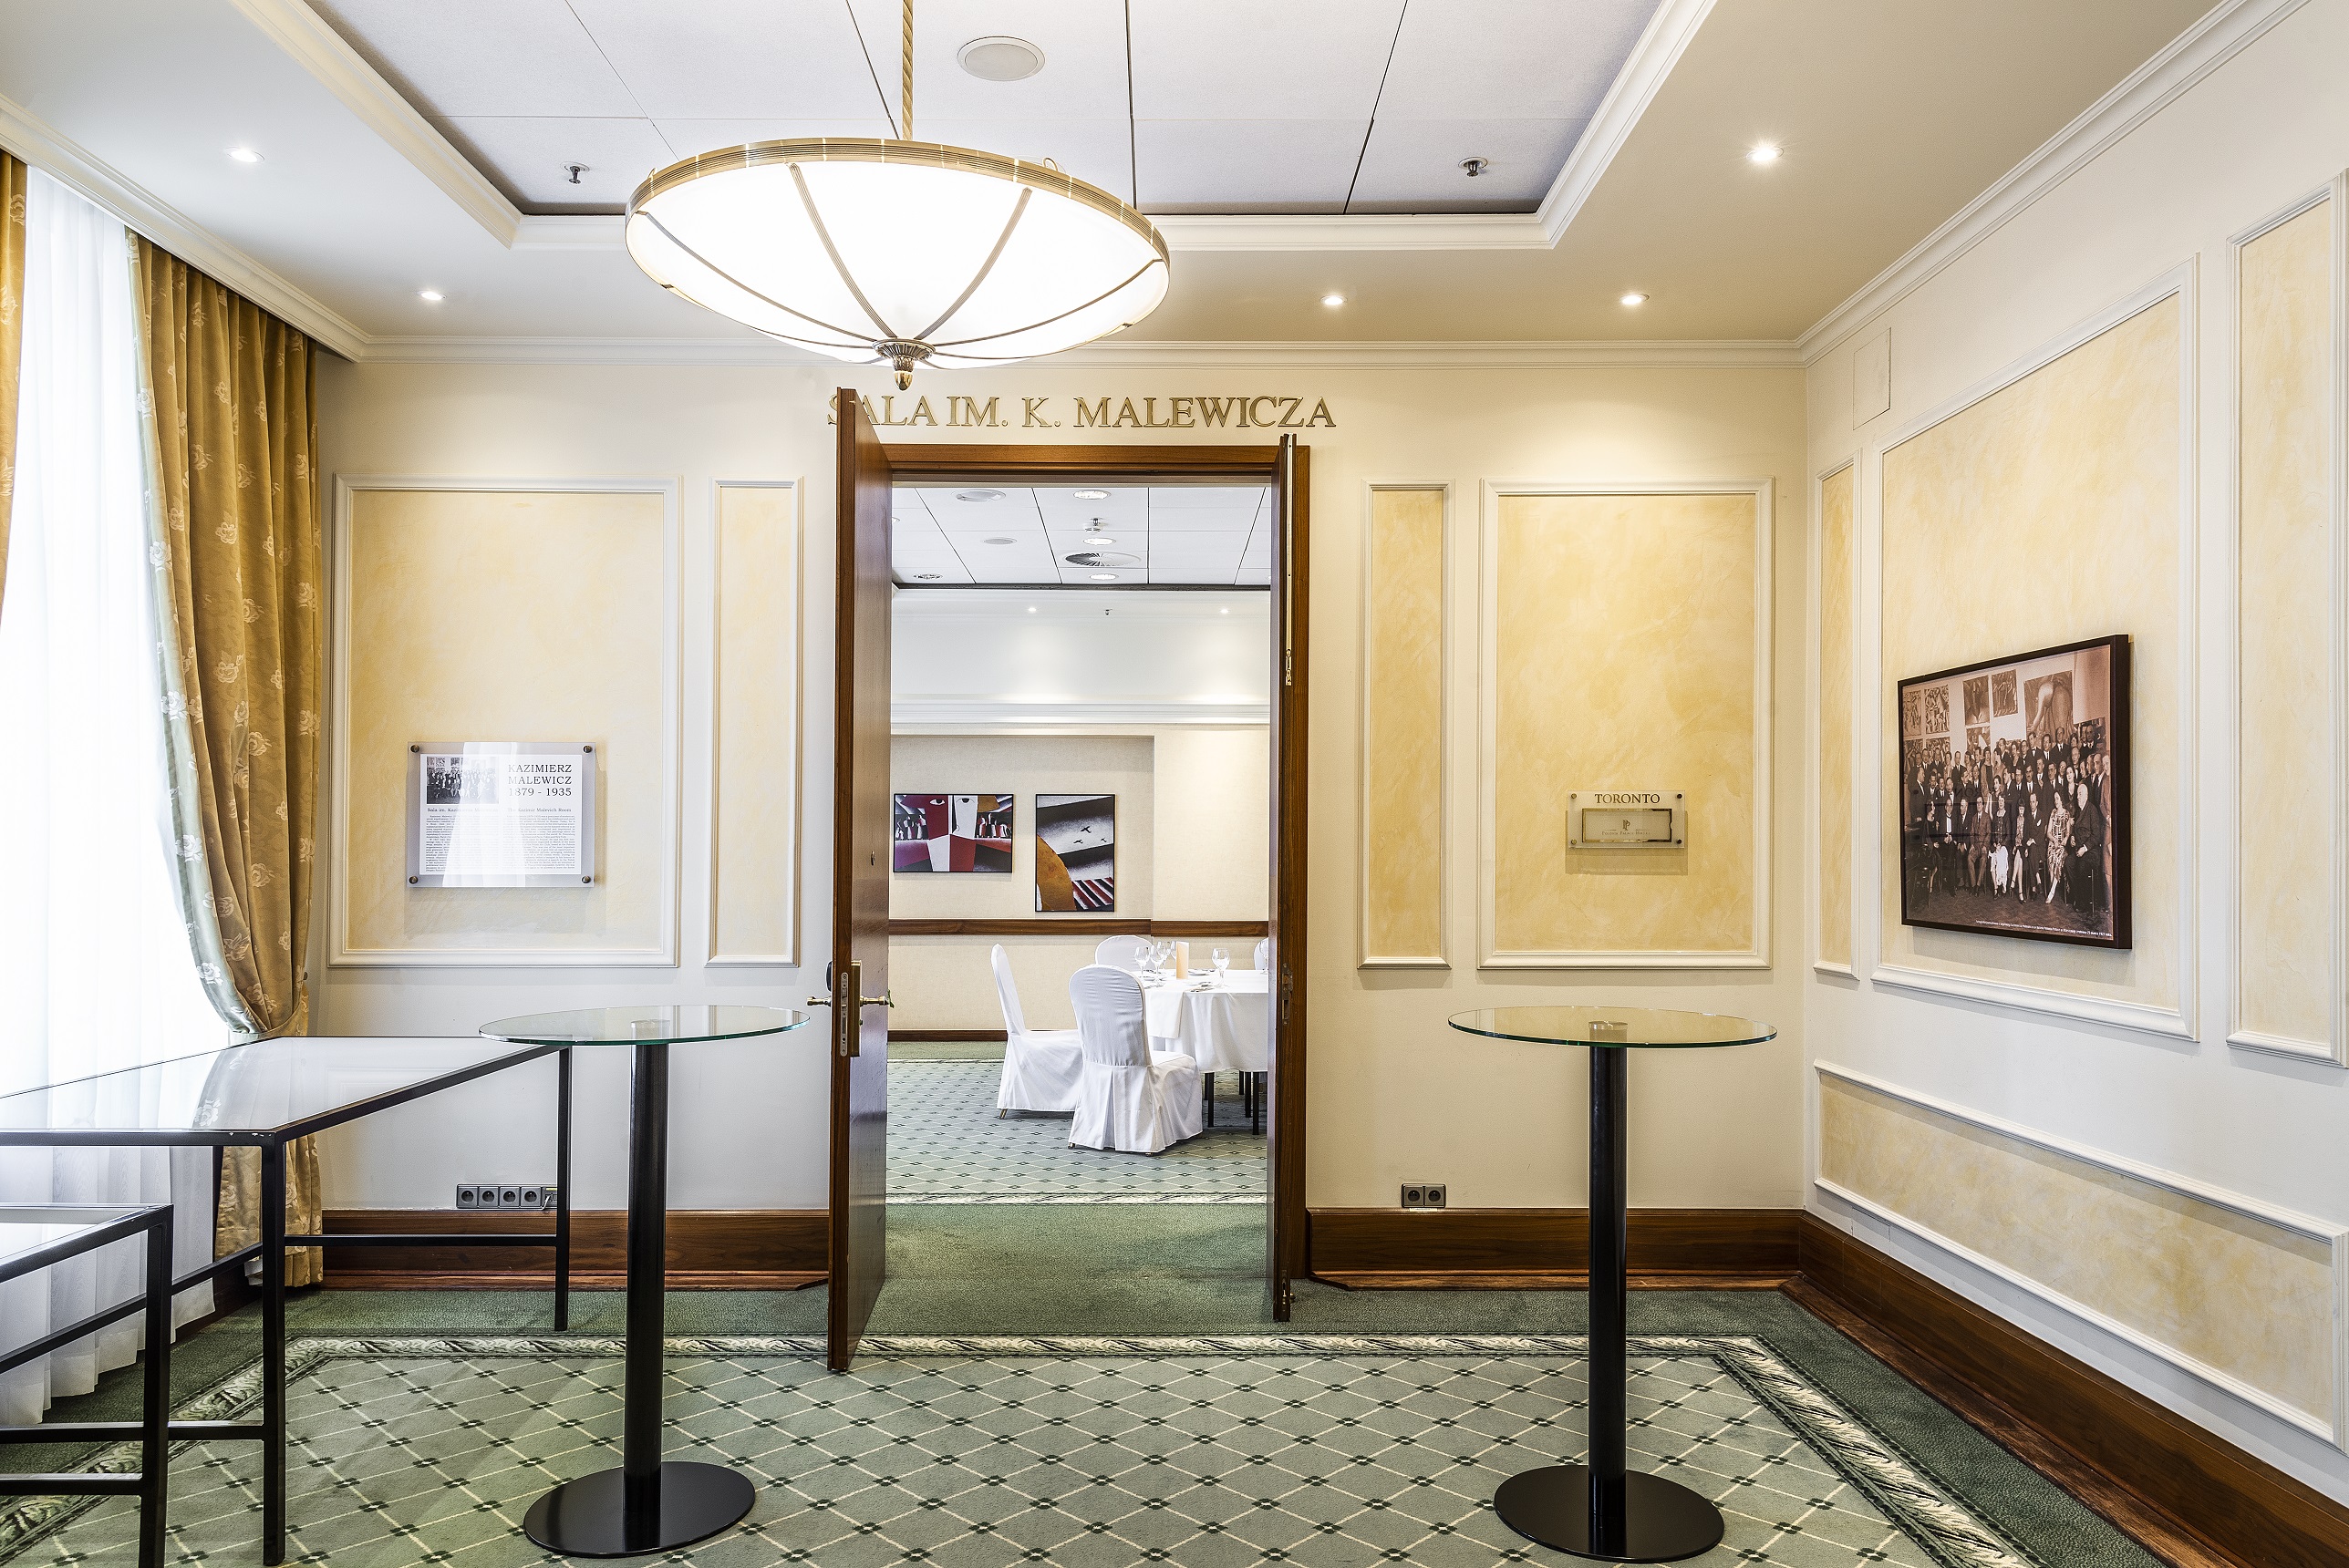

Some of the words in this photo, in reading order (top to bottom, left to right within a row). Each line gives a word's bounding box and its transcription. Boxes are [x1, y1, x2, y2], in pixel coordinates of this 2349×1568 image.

[946, 395, 1009, 427] IM.
[1022, 396, 1061, 428] K.
[1073, 396, 1338, 428] MALEWICZA
[508, 764, 573, 773] KAZIMIERZ
[508, 776, 573, 785] MALEWICZ
[509, 788, 534, 797] 1879
[546, 788, 572, 797] 1935
[1594, 793, 1661, 804] TORONTO
